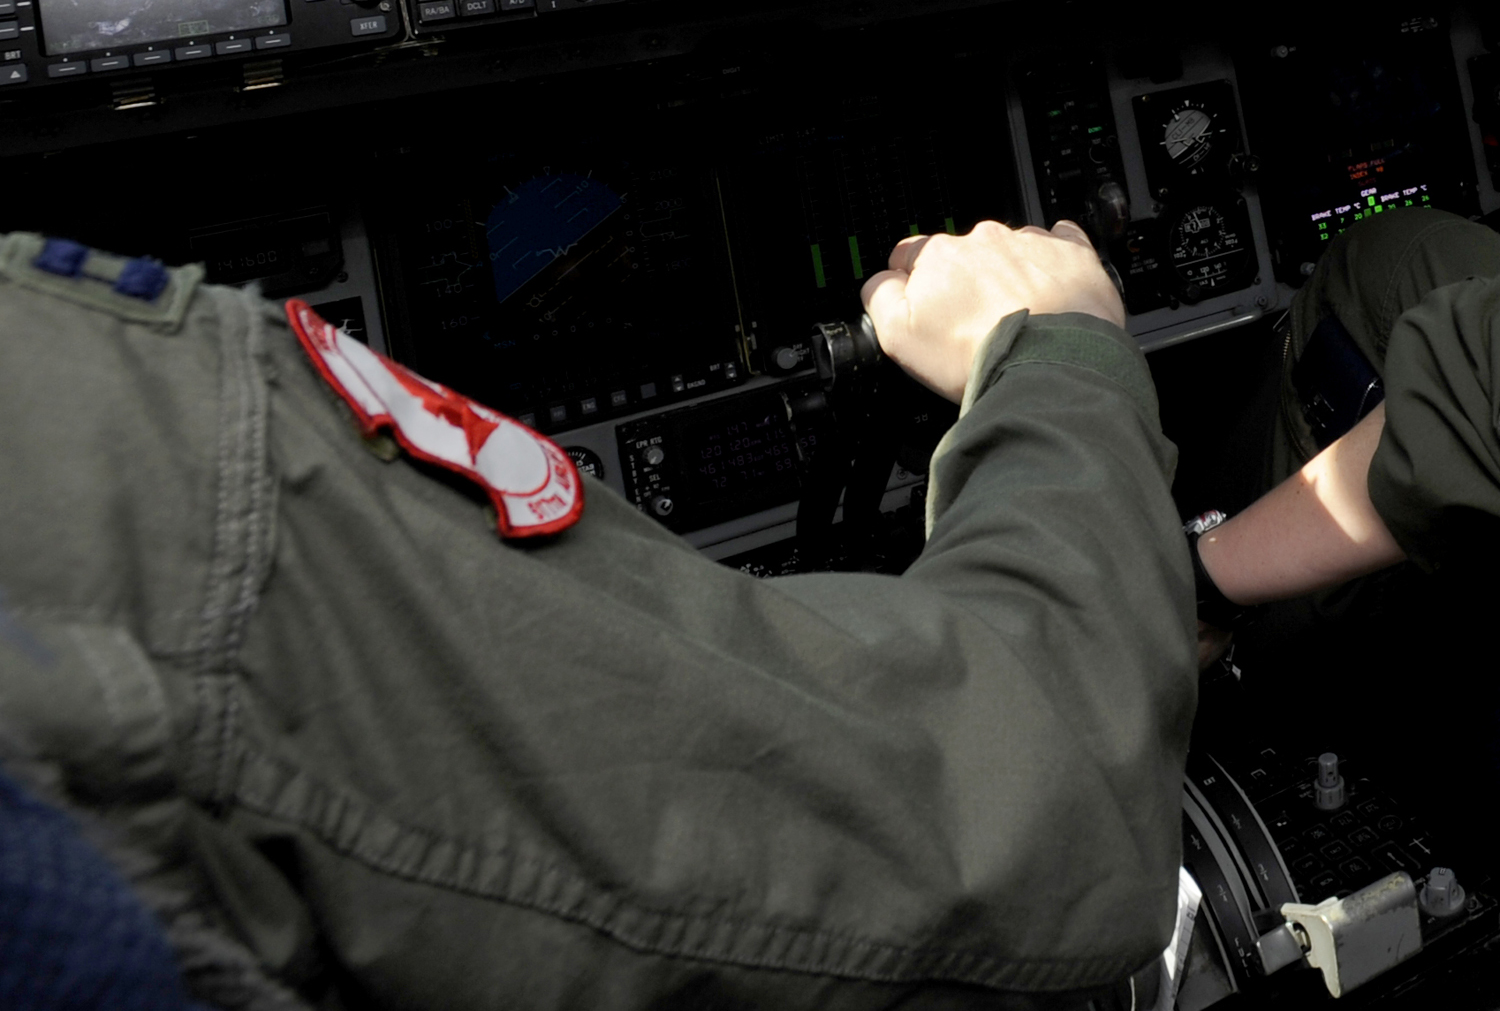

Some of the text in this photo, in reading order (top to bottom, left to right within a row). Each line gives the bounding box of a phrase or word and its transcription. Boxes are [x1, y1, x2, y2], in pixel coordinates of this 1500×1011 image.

[466, 0, 487, 10] DCLT
[424, 5, 450, 16] RA/BA
[359, 20, 379, 31] XFER
[648, 473, 661, 483] SEL
